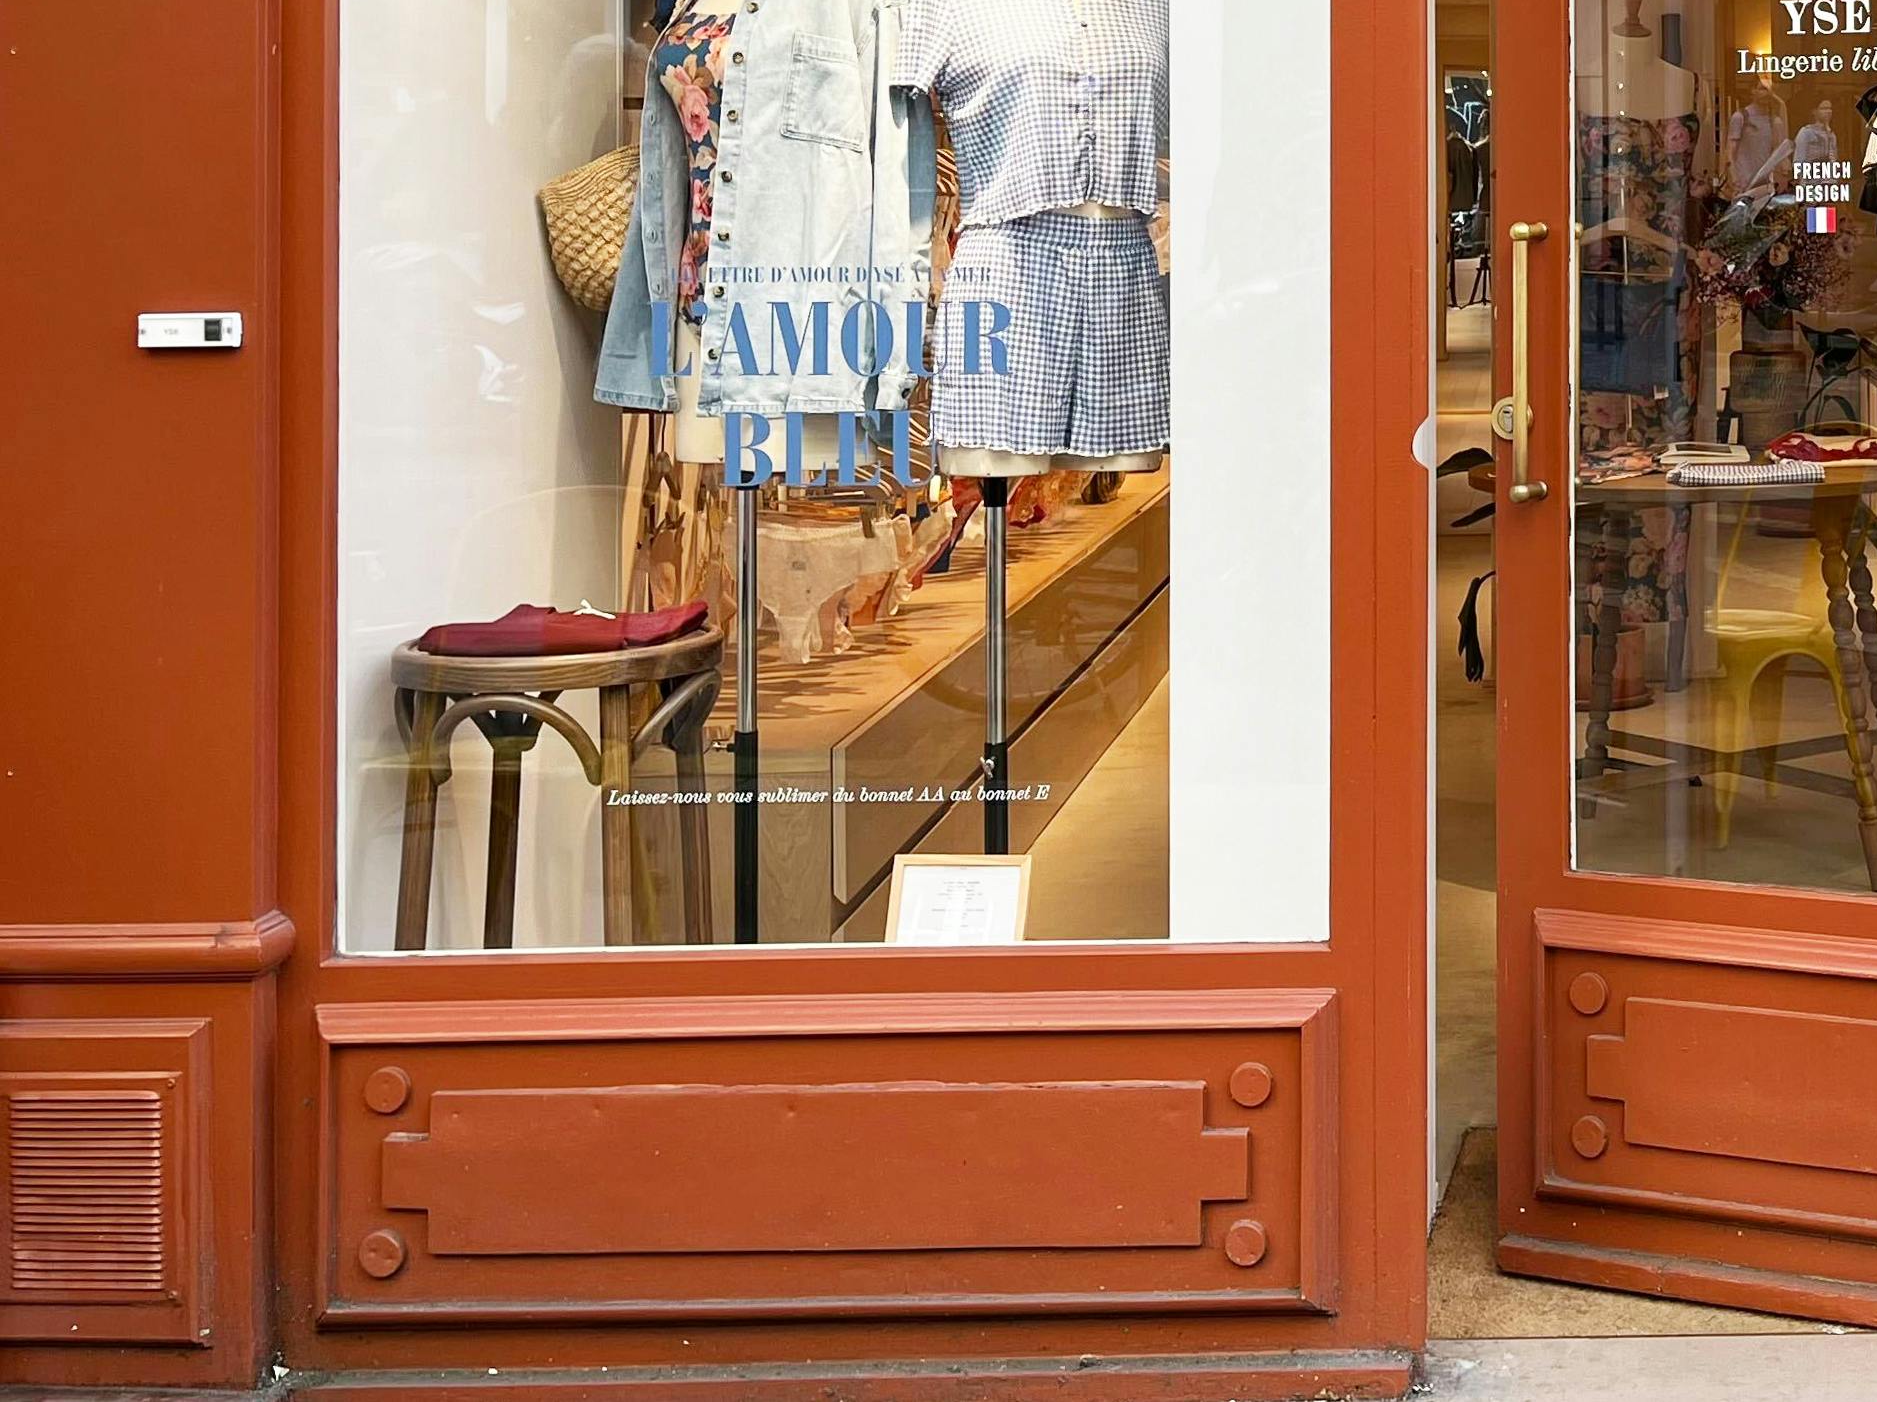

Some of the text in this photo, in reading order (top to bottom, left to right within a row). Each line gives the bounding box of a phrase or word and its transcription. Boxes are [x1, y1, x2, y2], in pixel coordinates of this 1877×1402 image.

[1737, 49, 1844, 79] Lingerie
[1793, 161, 1851, 180] FRENCH
[1795, 185, 1850, 202] DESIGN
[698, 266, 765, 284] ETTRE
[771, 266, 849, 284] D'AMOUR
[856, 261, 905, 283] DYSÉ
[649, 300, 1013, 377] L'AMOUR
[722, 410, 938, 487] BLEU
[607, 789, 712, 806] Laissez-nous
[717, 790, 753, 803] vous
[757, 787, 829, 804] sublimer
[833, 787, 855, 803] du
[859, 786, 914, 802] bonnet
[950, 788, 972, 801] au
[977, 785, 1031, 801] bonnet
[1034, 784, 1051, 800] E
